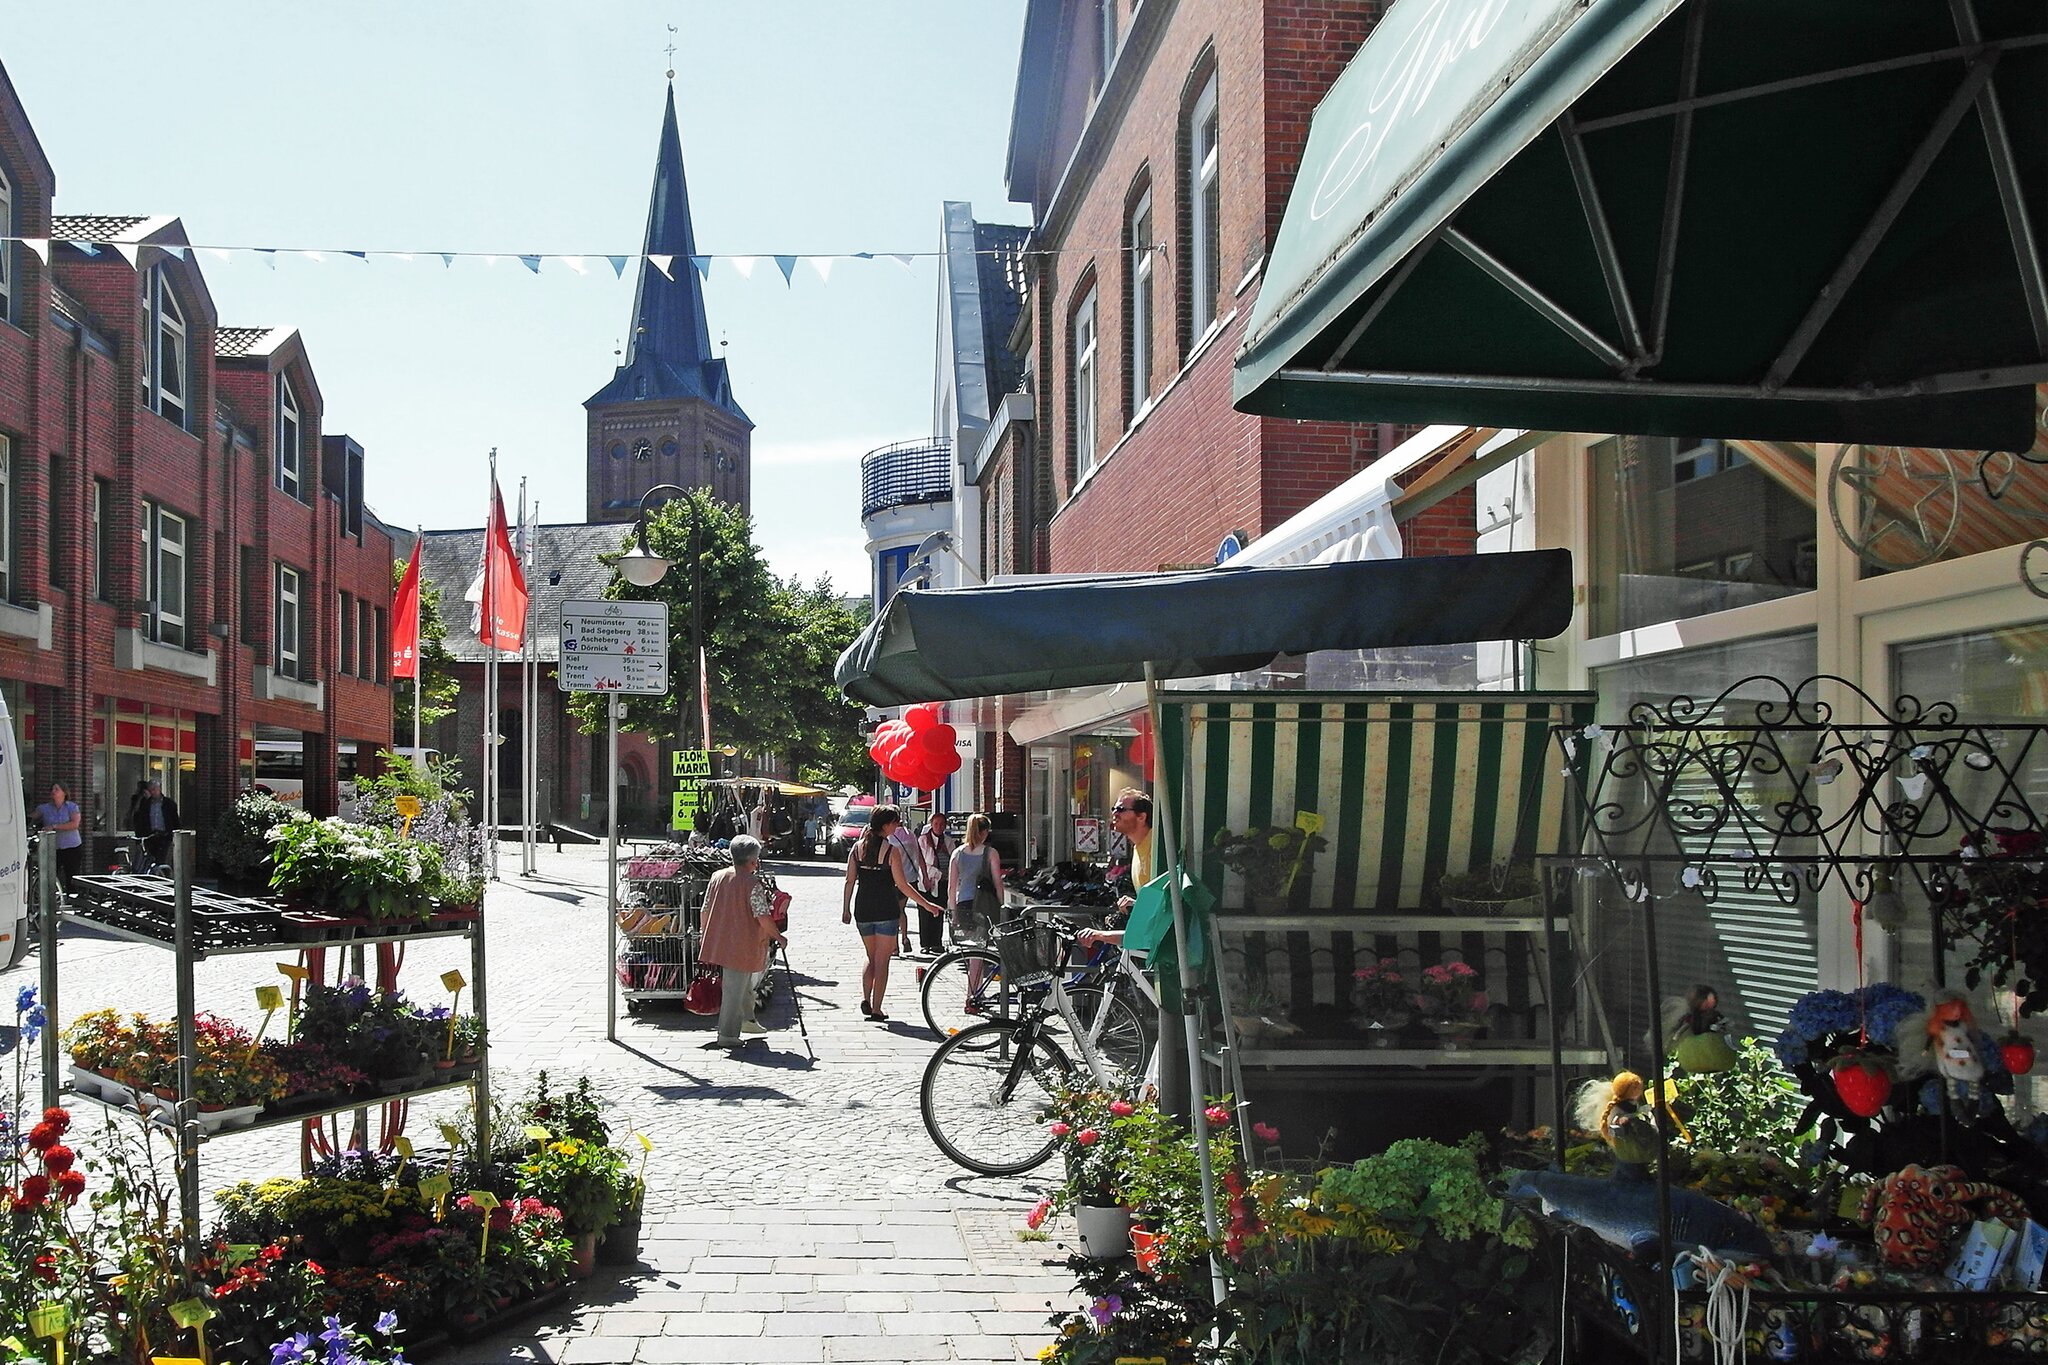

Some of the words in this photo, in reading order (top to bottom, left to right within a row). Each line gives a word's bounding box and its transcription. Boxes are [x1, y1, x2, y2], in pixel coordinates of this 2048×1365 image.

[581, 618, 625, 626] Neumünster
[596, 628, 631, 636] Segeberg
[581, 635, 619, 644] Ascheberg
[581, 644, 609, 652] Dörnick
[566, 663, 589, 671] Preetz
[566, 672, 585, 680] Trent
[566, 680, 592, 688] Tramm
[675, 763, 709, 774] MARKT
